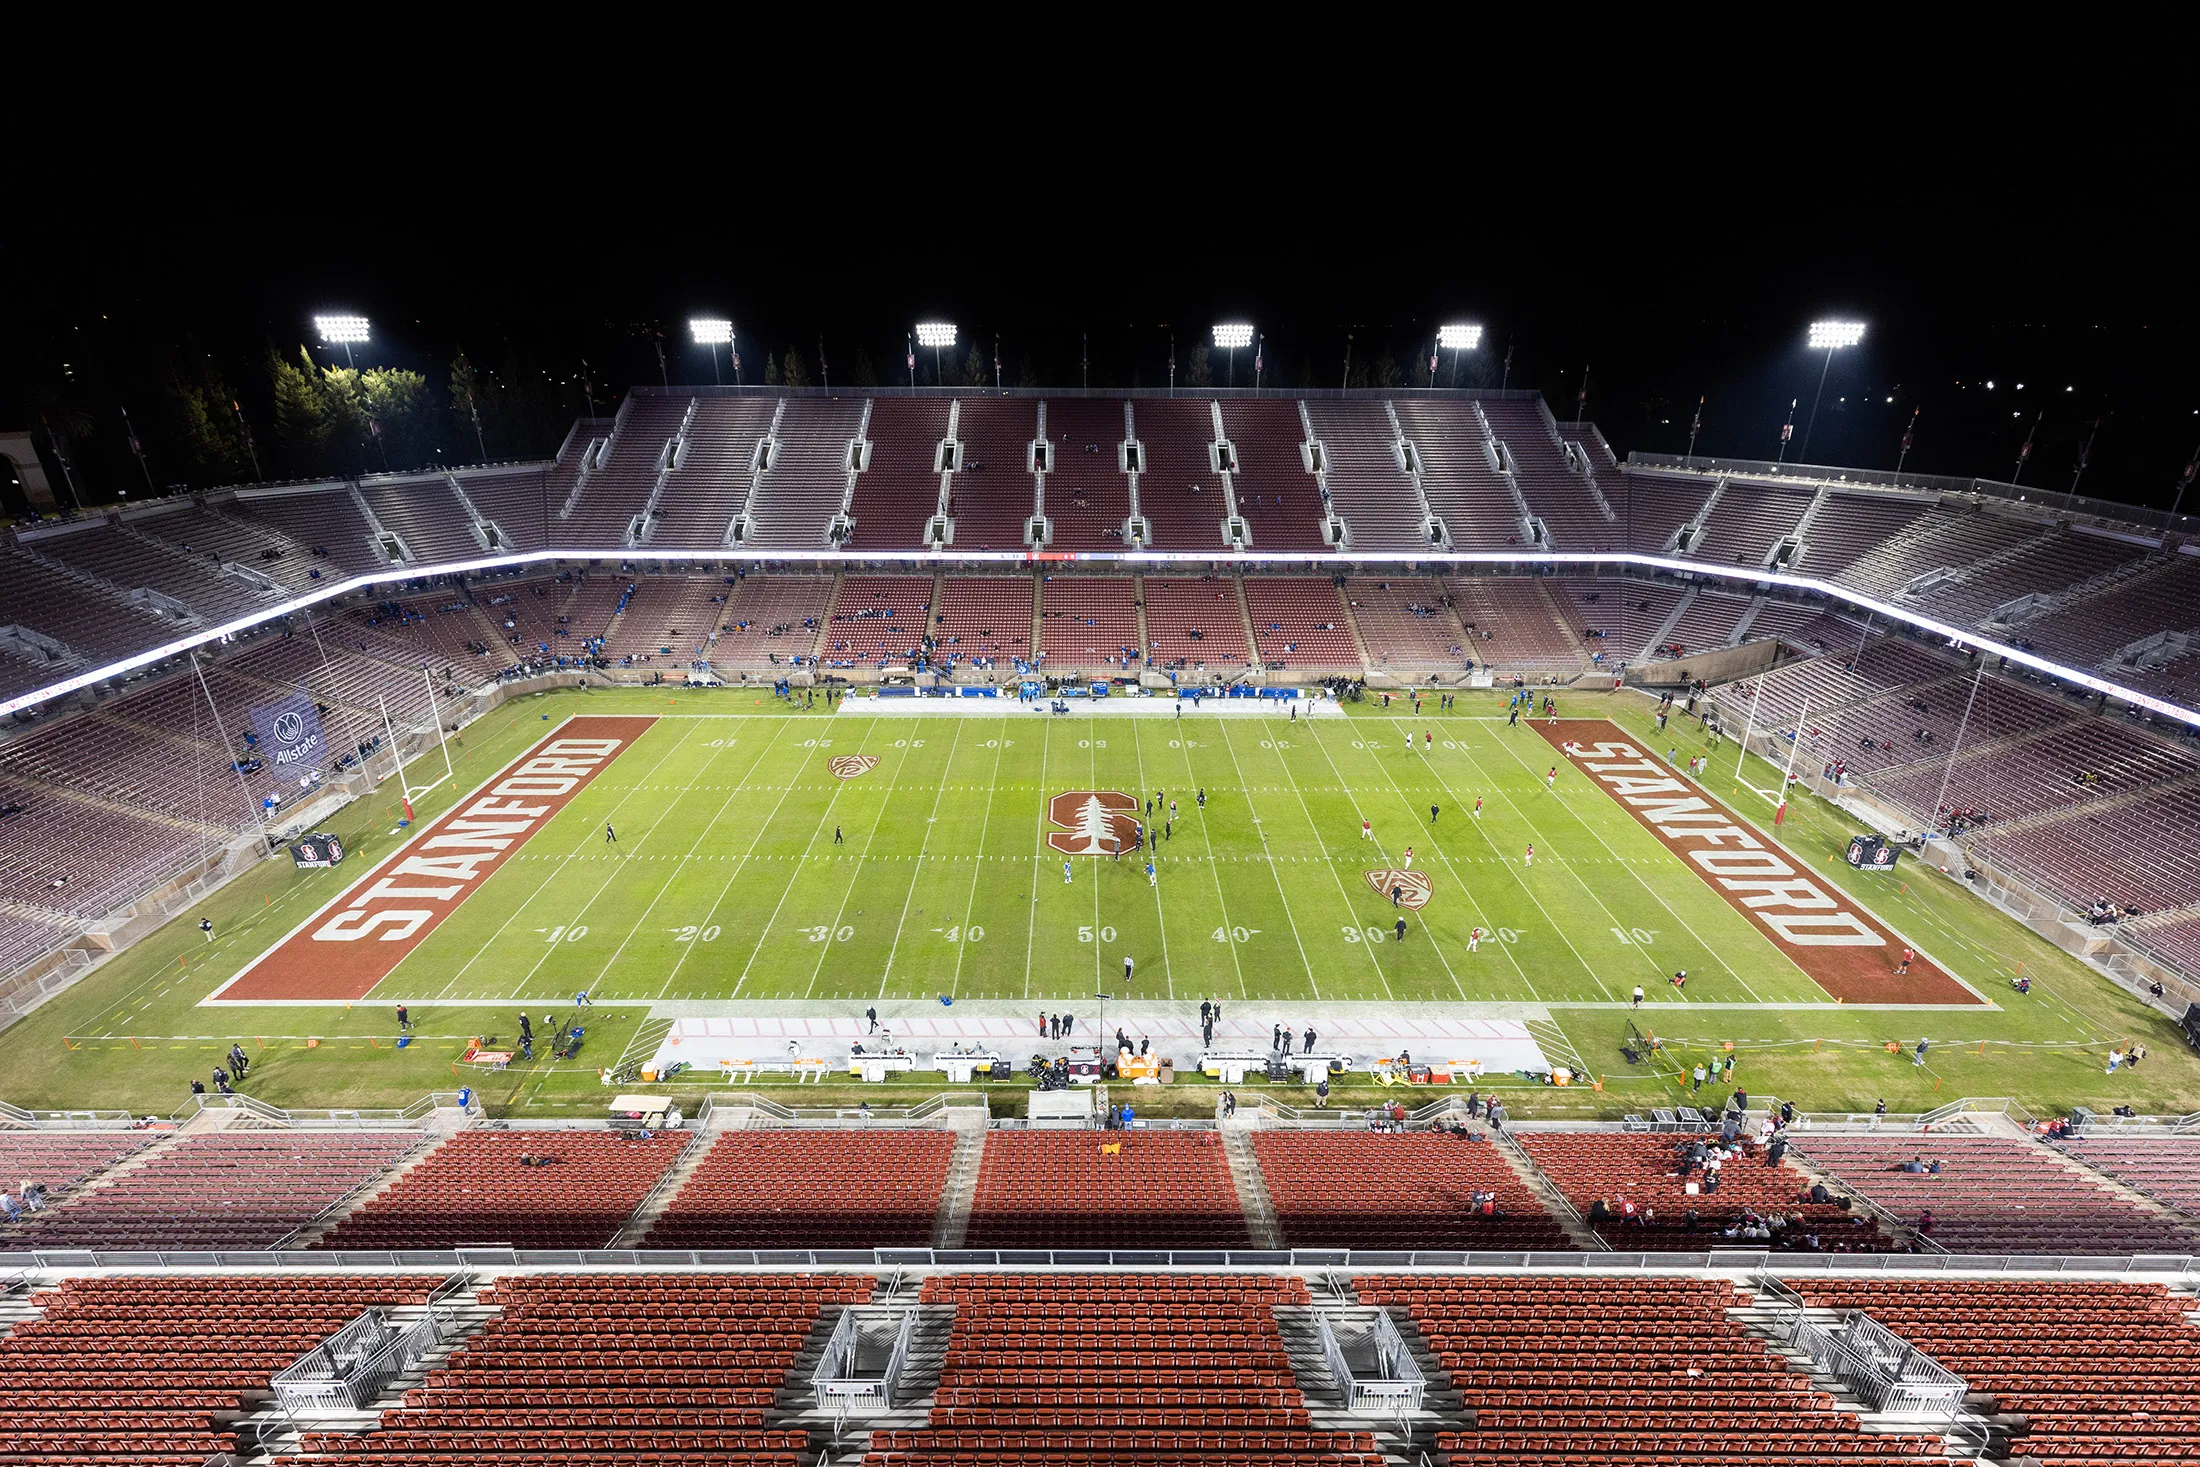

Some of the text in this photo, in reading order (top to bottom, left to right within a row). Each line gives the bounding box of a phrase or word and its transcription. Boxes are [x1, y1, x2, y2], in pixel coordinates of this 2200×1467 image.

[276, 734, 318, 765] Allstate
[312, 738, 623, 941] STANFORD
[1562, 741, 1886, 946] STANFORD
[544, 926, 588, 942] 10
[675, 926, 721, 942] 20
[809, 926, 854, 942] 30
[944, 926, 984, 942] 40
[1077, 926, 1117, 942] 50
[1211, 926, 1250, 942] 40
[1341, 927, 1385, 943] 30
[1478, 927, 1519, 943] 20
[1610, 927, 1654, 944] 10
